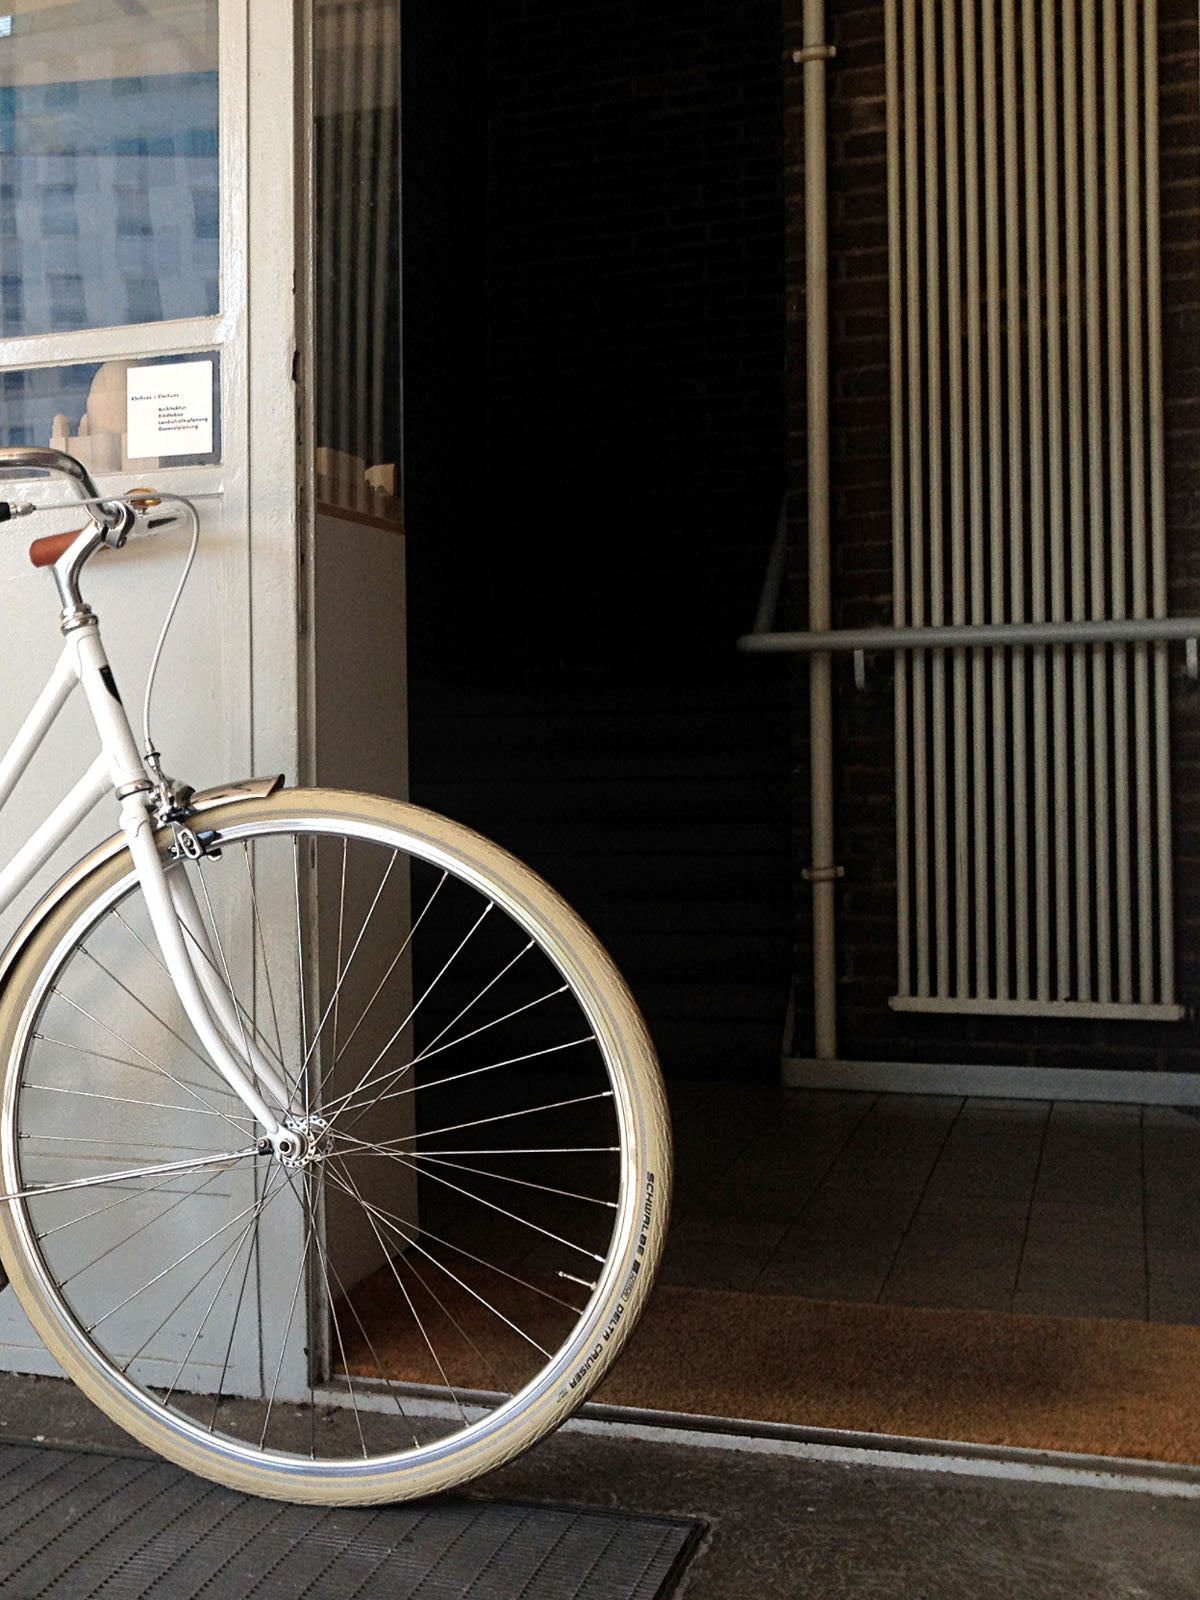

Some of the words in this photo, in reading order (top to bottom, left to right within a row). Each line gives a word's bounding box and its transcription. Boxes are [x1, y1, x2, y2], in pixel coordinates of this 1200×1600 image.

[637, 1171, 655, 1256] SCHWALBE
[602, 1303, 625, 1341] DELTA
[568, 1343, 604, 1389] CRUISER
